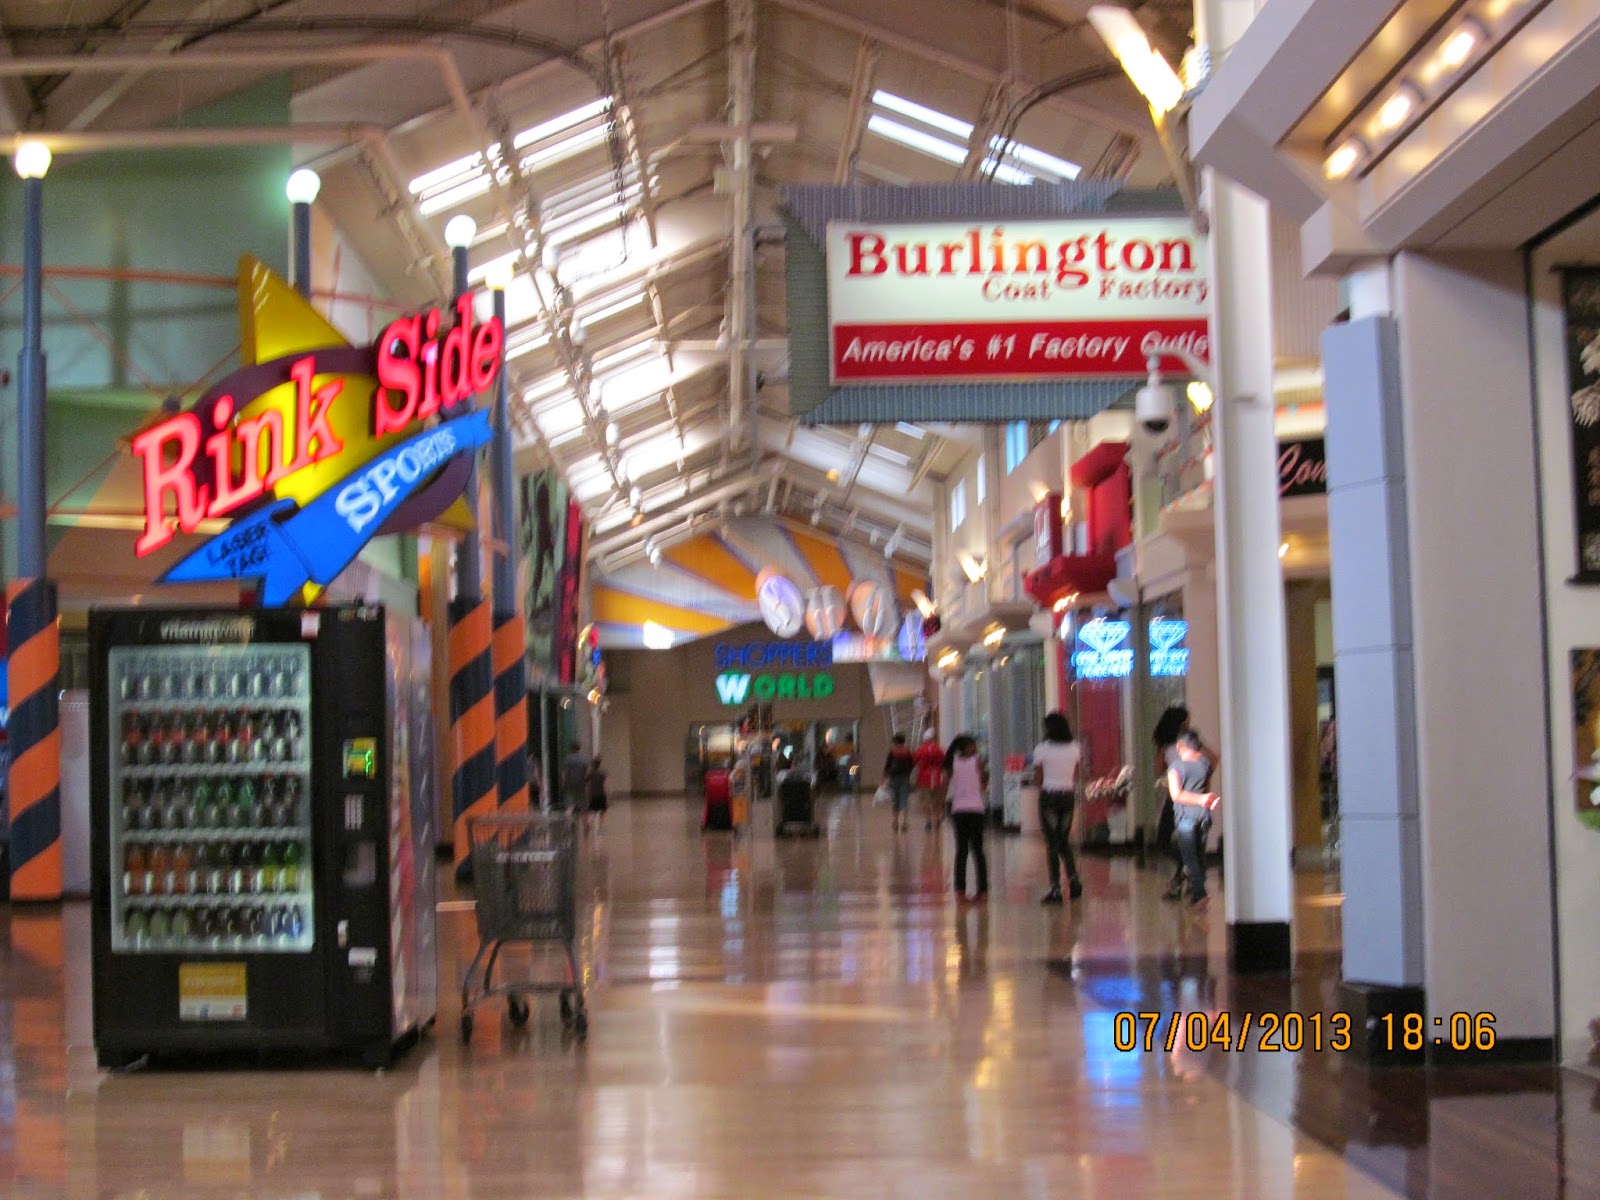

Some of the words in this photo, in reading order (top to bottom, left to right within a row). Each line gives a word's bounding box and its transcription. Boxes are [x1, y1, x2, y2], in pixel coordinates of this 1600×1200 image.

[843, 225, 1196, 288] Burlington
[981, 274, 1052, 302] Coat
[1098, 275, 1209, 304] Factory
[841, 333, 976, 364] America's
[986, 333, 1016, 361] #1
[1028, 332, 1131, 363] Factory
[1139, 329, 1208, 357] Outle
[132, 356, 346, 558] Rink
[375, 291, 503, 440] Side
[334, 426, 457, 534] SPORTS
[715, 640, 834, 668] SHOPPERS
[715, 669, 835, 705] WORLD
